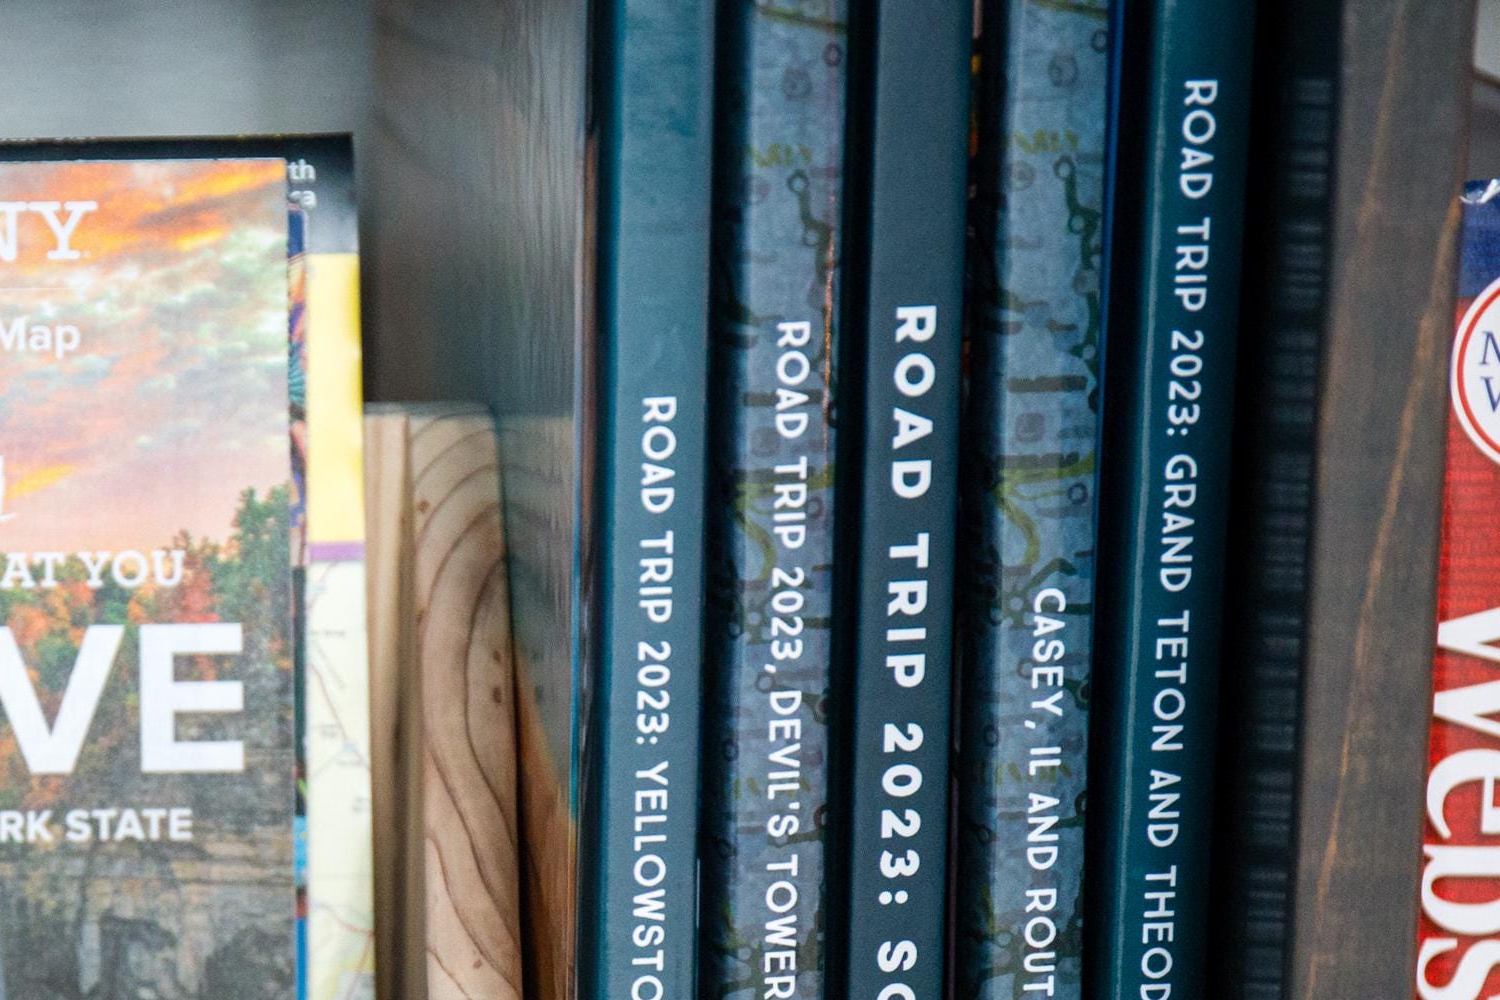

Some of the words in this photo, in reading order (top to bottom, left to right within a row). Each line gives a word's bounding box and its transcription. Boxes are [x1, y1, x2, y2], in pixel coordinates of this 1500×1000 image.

[1179, 80, 1218, 199] ROAD
[1174, 217, 1211, 311] TRIP
[774, 320, 811, 439] ROAD
[891, 305, 937, 499] ROAD
[1166, 330, 1204, 436] 2023:
[640, 396, 677, 514] ROAD
[772, 455, 808, 549] TRIP
[76, 549, 187, 591] YOU
[639, 530, 674, 623] TRIP
[1159, 454, 1197, 592] GRAND
[763, 566, 805, 674] 2023,
[885, 532, 930, 688] TRIP
[1023, 587, 1066, 730] CASEY,
[636, 641, 671, 745] 2023:
[1150, 609, 1190, 751] TETON
[766, 690, 802, 838] DEVIL'S
[878, 723, 924, 905] 2023:
[1028, 746, 1062, 776] IL
[1147, 769, 1182, 848] AND
[65, 806, 194, 844] STATE
[1026, 792, 1060, 871] AND
